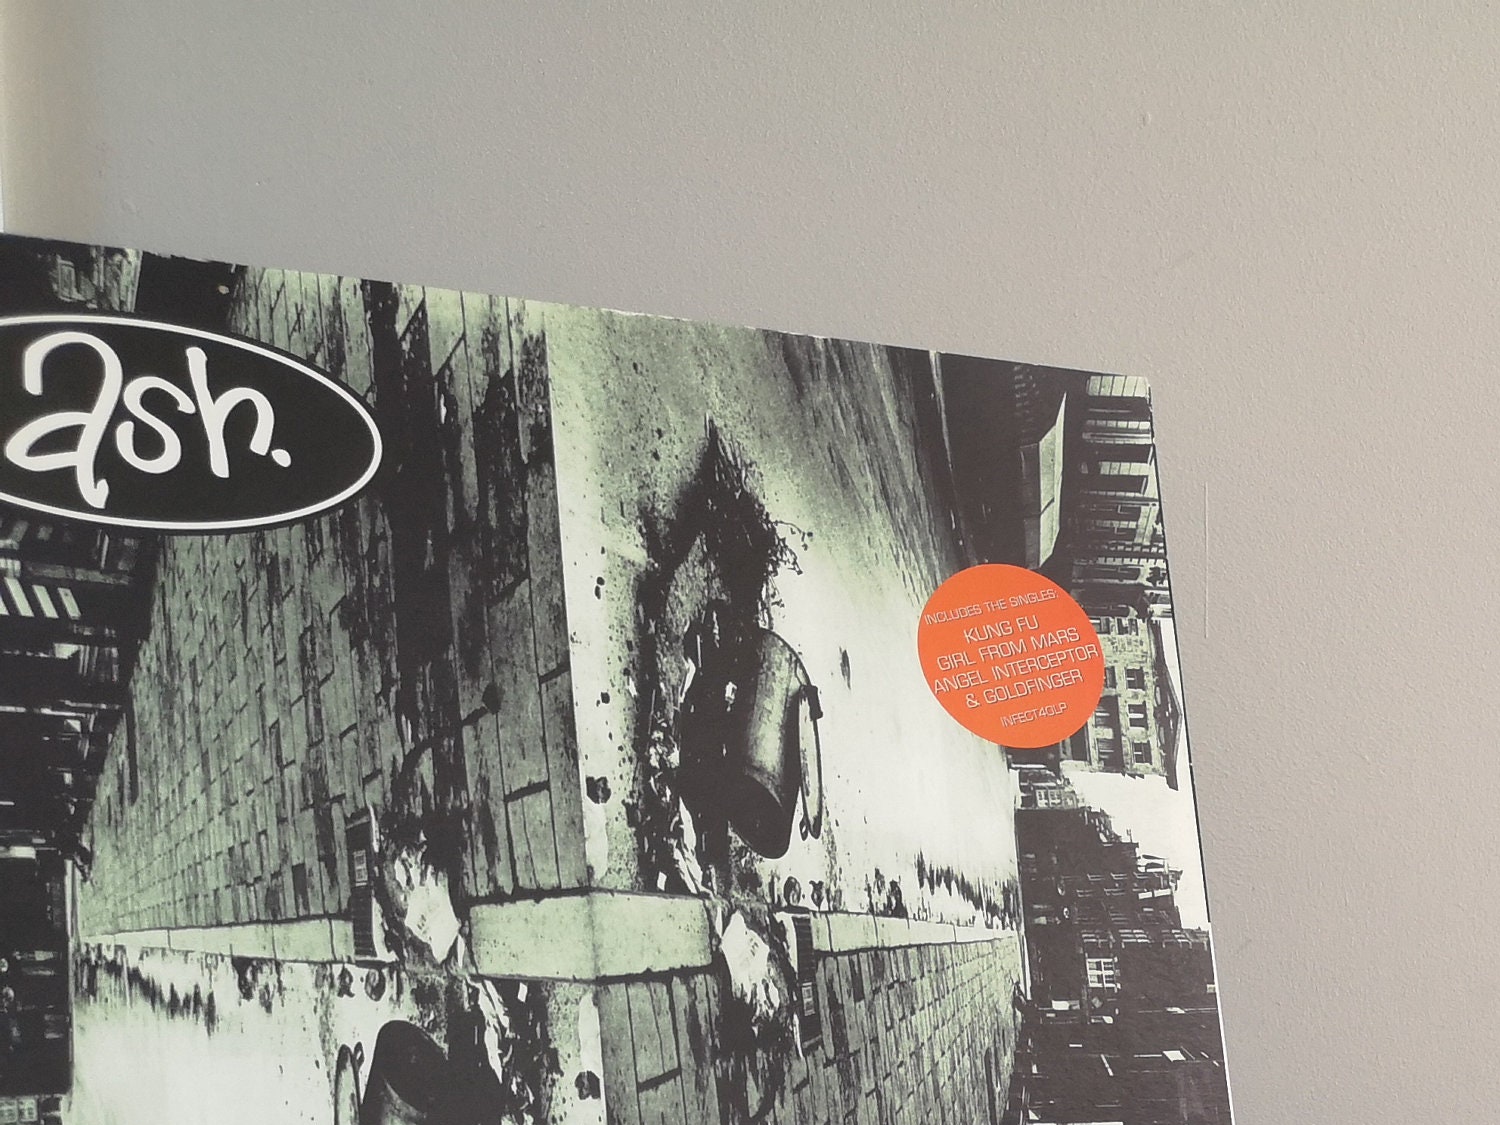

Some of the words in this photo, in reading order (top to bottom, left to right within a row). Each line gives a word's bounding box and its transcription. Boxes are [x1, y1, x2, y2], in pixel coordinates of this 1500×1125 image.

[924, 603, 983, 625] INCLUDES
[986, 598, 1008, 613] THE
[1009, 588, 1059, 608] SINGLES:
[936, 650, 977, 672] GIRL
[978, 639, 1028, 662] FROM
[1030, 627, 1081, 651] MARS
[963, 620, 1014, 644] KUNG
[1016, 614, 1040, 632] FU
[933, 670, 989, 695] ANGEL
[991, 643, 1099, 681] INTERCEPTOR
[964, 692, 981, 709] &
[982, 668, 1084, 705] GOLDFINGER
